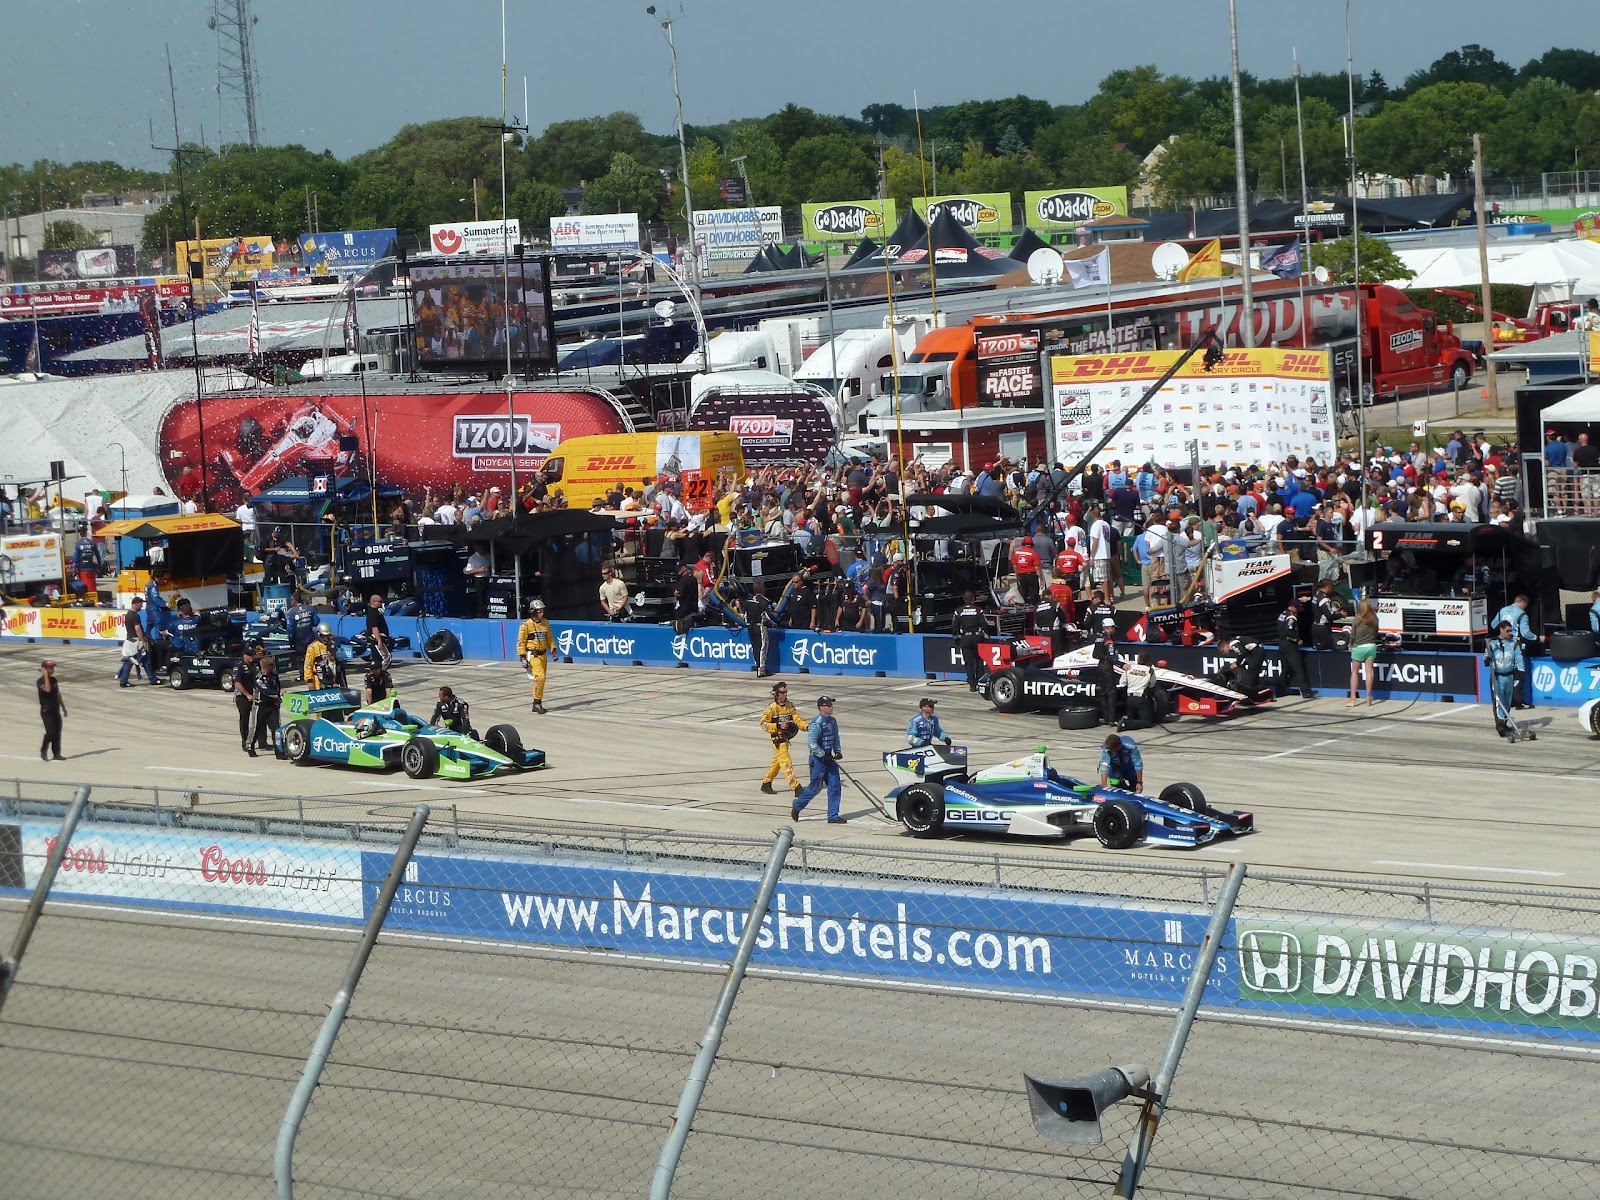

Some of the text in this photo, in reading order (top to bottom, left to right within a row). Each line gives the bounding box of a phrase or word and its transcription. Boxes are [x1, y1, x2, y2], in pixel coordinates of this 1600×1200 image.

[928, 203, 978, 230] Goaddy
[464, 225, 517, 237] Summerfest
[555, 222, 581, 236] ABC
[709, 230, 780, 243] DAVIDHOBBScom
[326, 247, 376, 259] ARCUS
[74, 293, 91, 301] Gear
[980, 338, 1018, 356] IZOD
[1044, 343, 1068, 351] HONDA
[1070, 340, 1088, 352] THE
[1392, 332, 1412, 346] IZOD
[998, 367, 1032, 376] FASTEST
[1073, 355, 1156, 377] DHL
[1231, 366, 1262, 374] CIRCLE
[1282, 354, 1321, 373] DHL
[986, 374, 1034, 395] RACE
[733, 420, 772, 434] IZOD
[459, 422, 523, 449] IZOD
[587, 455, 637, 471] DHL
[712, 453, 734, 462] DHL
[688, 480, 708, 499] 22
[1373, 531, 1382, 549] 2
[1404, 532, 1434, 540] TEAM
[372, 545, 394, 554] BMC
[1238, 568, 1276, 577] PENSKE
[1245, 560, 1273, 569] TEAM
[1, 611, 37, 631] Sun Drop
[47, 618, 79, 630] DHL
[90, 613, 126, 634] Sun Drop
[1134, 624, 1146, 642] 2
[576, 633, 635, 655] Charter
[690, 636, 753, 660] Charter
[811, 642, 877, 665] Charter
[991, 647, 1001, 666] 2
[1203, 656, 1282, 678] HITH
[1350, 662, 1444, 685] HTACHI
[1023, 680, 1097, 697] HITACHI
[290, 698, 303, 714] 22
[886, 753, 897, 768] 11
[908, 789, 934, 803] Firestone
[200, 844, 267, 886] Coors
[501, 879, 1051, 974] www.MarcusHotels.com
[1125, 948, 1227, 973] MARCS
[1131, 972, 1164, 982] HOTELS
[1181, 975, 1221, 987] RERTS
[1312, 934, 1600, 1019] DAVIDHOB
